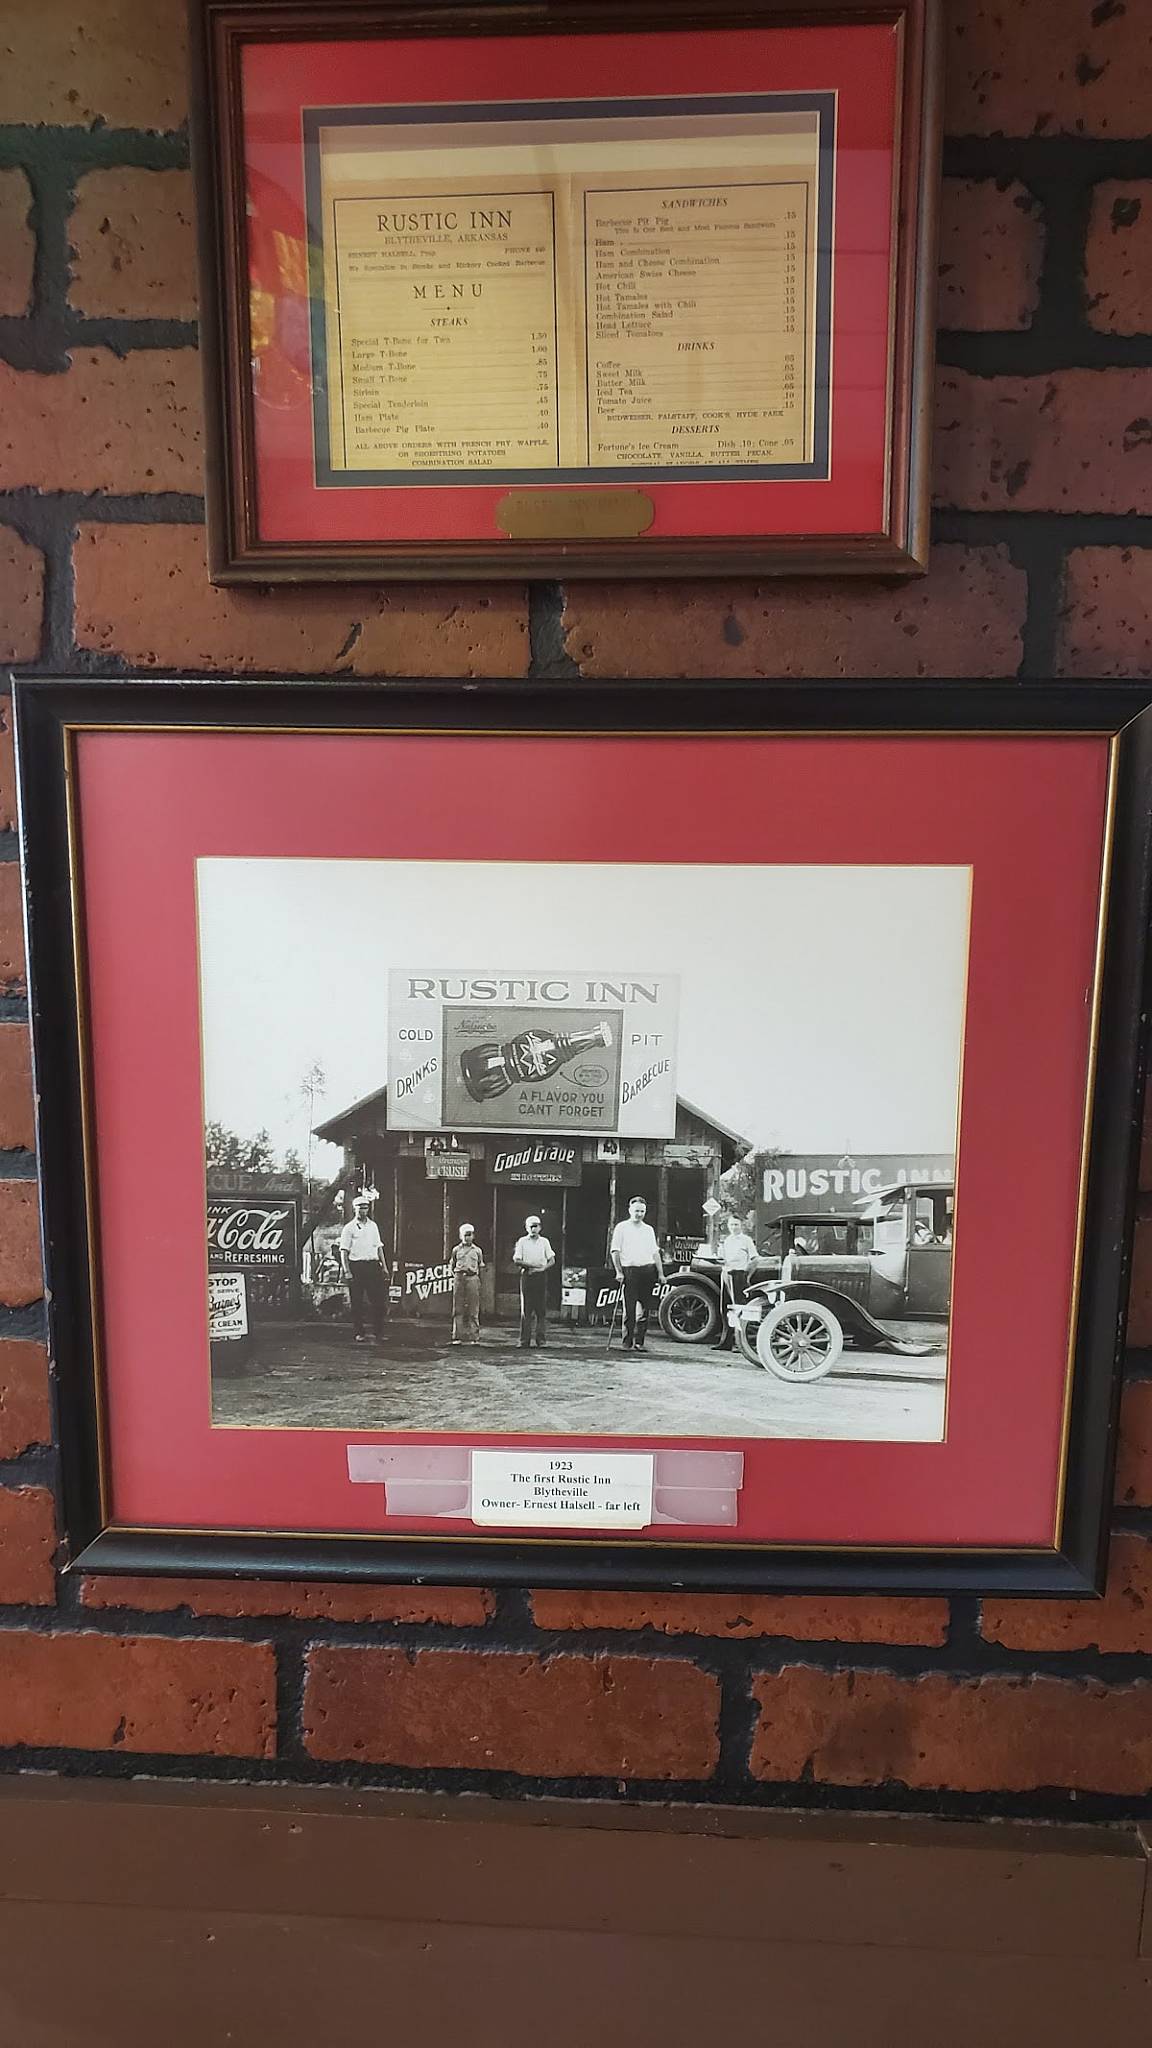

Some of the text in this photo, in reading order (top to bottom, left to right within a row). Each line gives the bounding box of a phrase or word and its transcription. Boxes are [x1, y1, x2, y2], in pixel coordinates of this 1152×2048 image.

[662, 198, 729, 209] SANDWICHES
[378, 211, 512, 232] RUSTIC INN
[637, 217, 649, 226] Pit
[655, 217, 670, 226] Pig
[784, 212, 797, 220] .15
[385, 233, 508, 245] BLYTHEVILLE, ARKANSAS
[595, 231, 796, 247] Ham .15
[504, 247, 531, 255] PHONE
[595, 243, 796, 258] Ham Combination .15
[595, 257, 720, 269] Ham and Cheese Combination
[596, 265, 796, 280] American Swiss Cheese .15
[595, 276, 796, 291] Hot Chili .15
[413, 283, 483, 299] MENU
[595, 292, 648, 302] Hot Tamales
[595, 303, 611, 311] Hot
[616, 301, 649, 310] Tamales
[655, 301, 673, 309] with
[678, 300, 697, 309] Chili
[596, 306, 796, 320] Combination Salad .15
[431, 317, 469, 327] STEAKS
[596, 321, 652, 330] Head Lettuce
[595, 325, 795, 339] Sliced Tomatoes .15
[351, 332, 547, 347] Special T-Bone for Two 1.50
[351, 350, 375, 359] Large
[531, 345, 548, 354] 1.00
[678, 342, 716, 351] DRINKS
[352, 358, 548, 372] Medium .85
[596, 361, 622, 369] Coffee
[352, 371, 548, 384] Small .75
[596, 369, 643, 378] Sweet Milk
[596, 379, 624, 387] Butter
[353, 384, 549, 397] Sirloin .75
[596, 383, 795, 397] Iced Tea .05
[353, 400, 381, 410] Special
[387, 399, 429, 408] Tenderloin
[597, 397, 652, 406] Tomato Juice
[597, 401, 795, 415] Beer .15
[354, 412, 399, 422] Ham Plate
[355, 423, 435, 434] Barbecue Pig Plate
[671, 424, 720, 435] DESSERTS
[402, 441, 432, 449] ORDERS
[461, 440, 492, 448] FRENCH
[598, 438, 794, 452] Fortune's Ice Cream Dish Cone .05
[711, 450, 740, 458] BUTTER
[408, 978, 660, 1004] RUSTIC INN
[399, 1029, 433, 1041] COLD
[632, 1035, 663, 1046] PIT
[396, 1057, 438, 1098] DRINKS
[622, 1059, 670, 1104] BARBECUE
[520, 1091, 605, 1104] A FLAVOR YOU
[519, 1104, 605, 1117] CANT FORGET
[493, 1145, 576, 1173] Good Grape
[763, 1168, 882, 1203] RUSTIC
[225, 1251, 285, 1264] REFRESHING
[406, 1265, 453, 1294] PEACH
[217, 1320, 243, 1328] CREAM
[550, 1462, 573, 1470] 1923
[511, 1474, 611, 1484] The first Rustic Inn
[534, 1487, 588, 1497] Blytheville
[482, 1499, 640, 1511] Owner- Ernest Halsell far left
